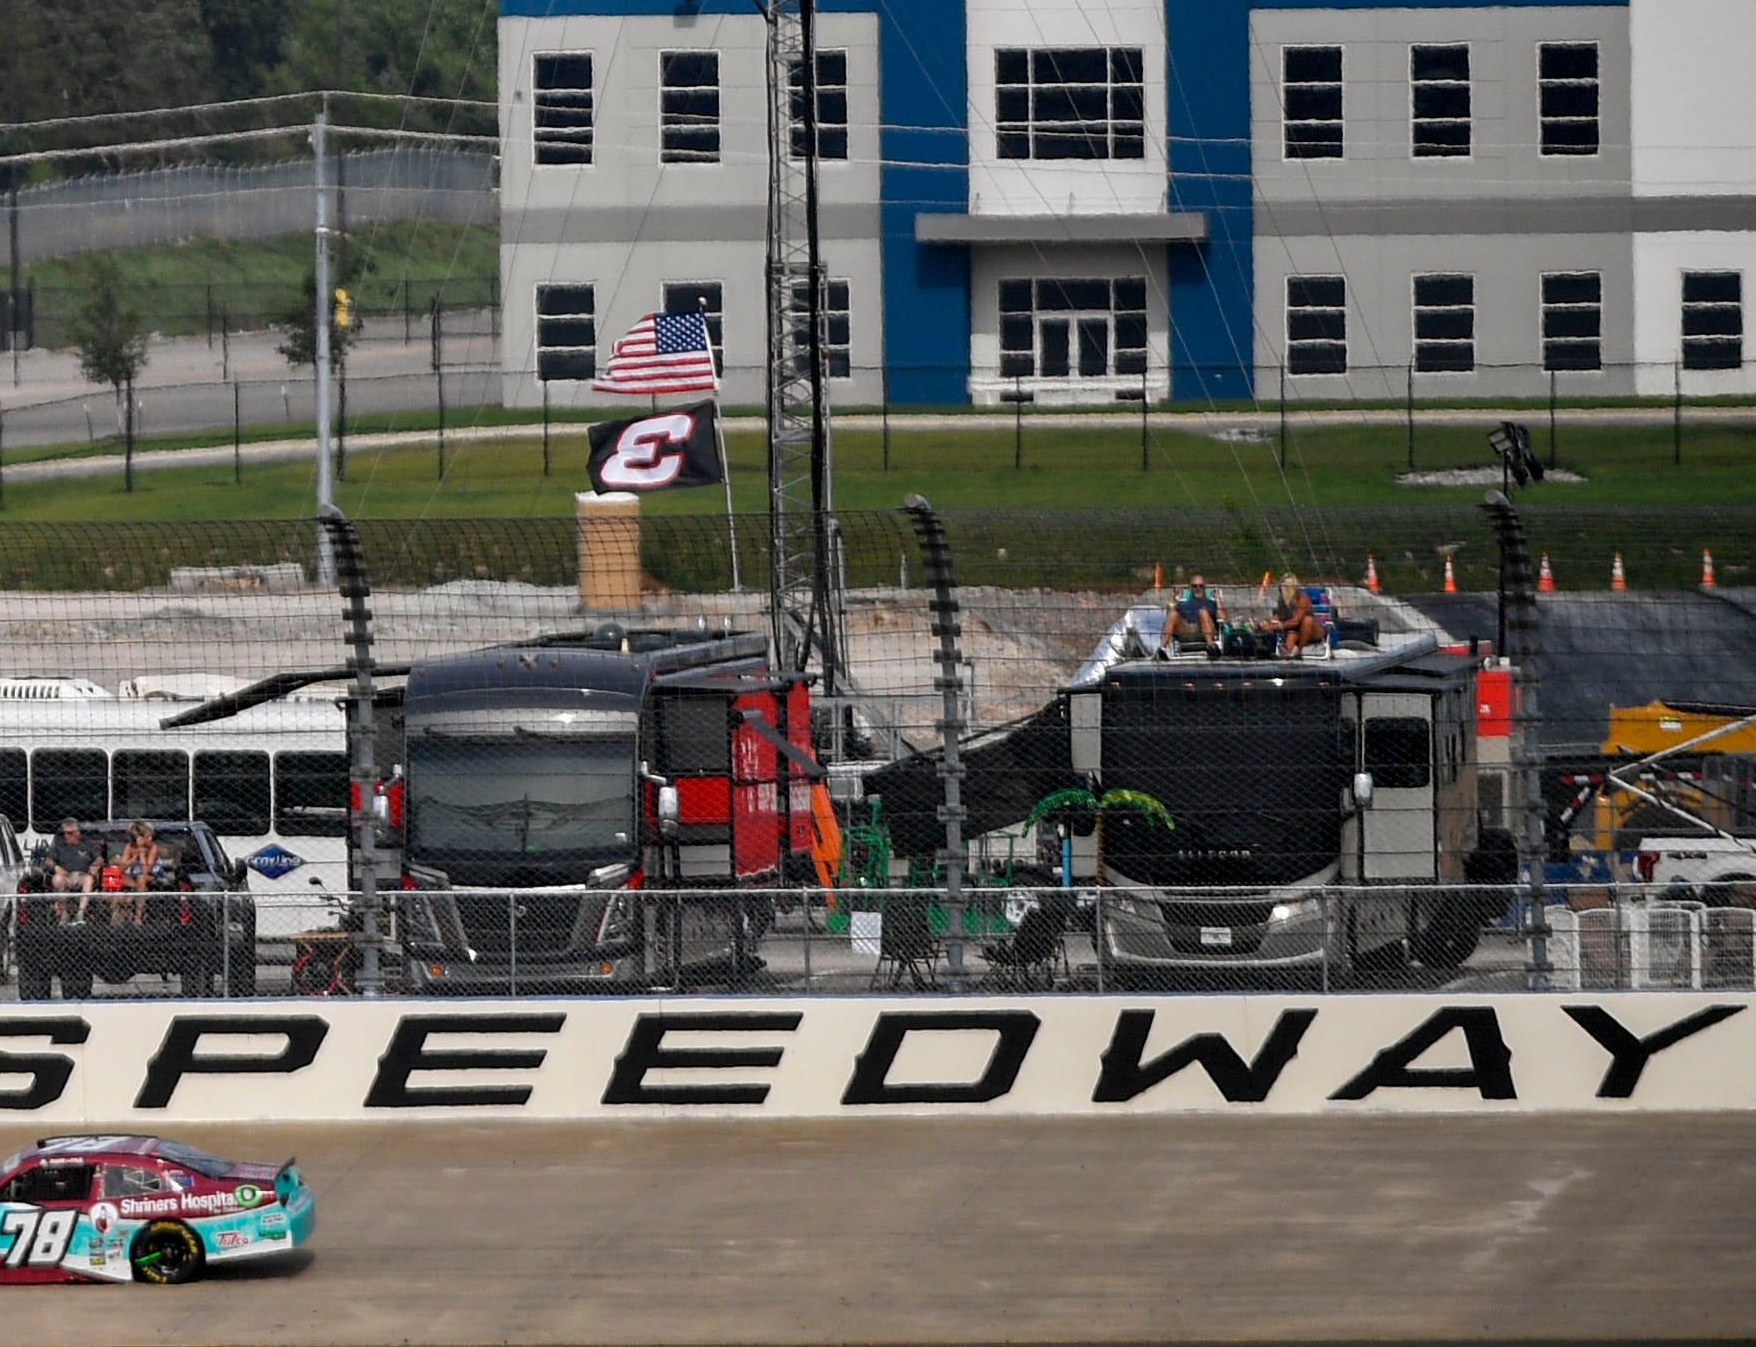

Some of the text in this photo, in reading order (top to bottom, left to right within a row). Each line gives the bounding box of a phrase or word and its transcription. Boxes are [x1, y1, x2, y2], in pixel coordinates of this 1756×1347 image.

[121, 1190, 239, 1214] Shriners Hospita
[0, 1209, 78, 1266] 78
